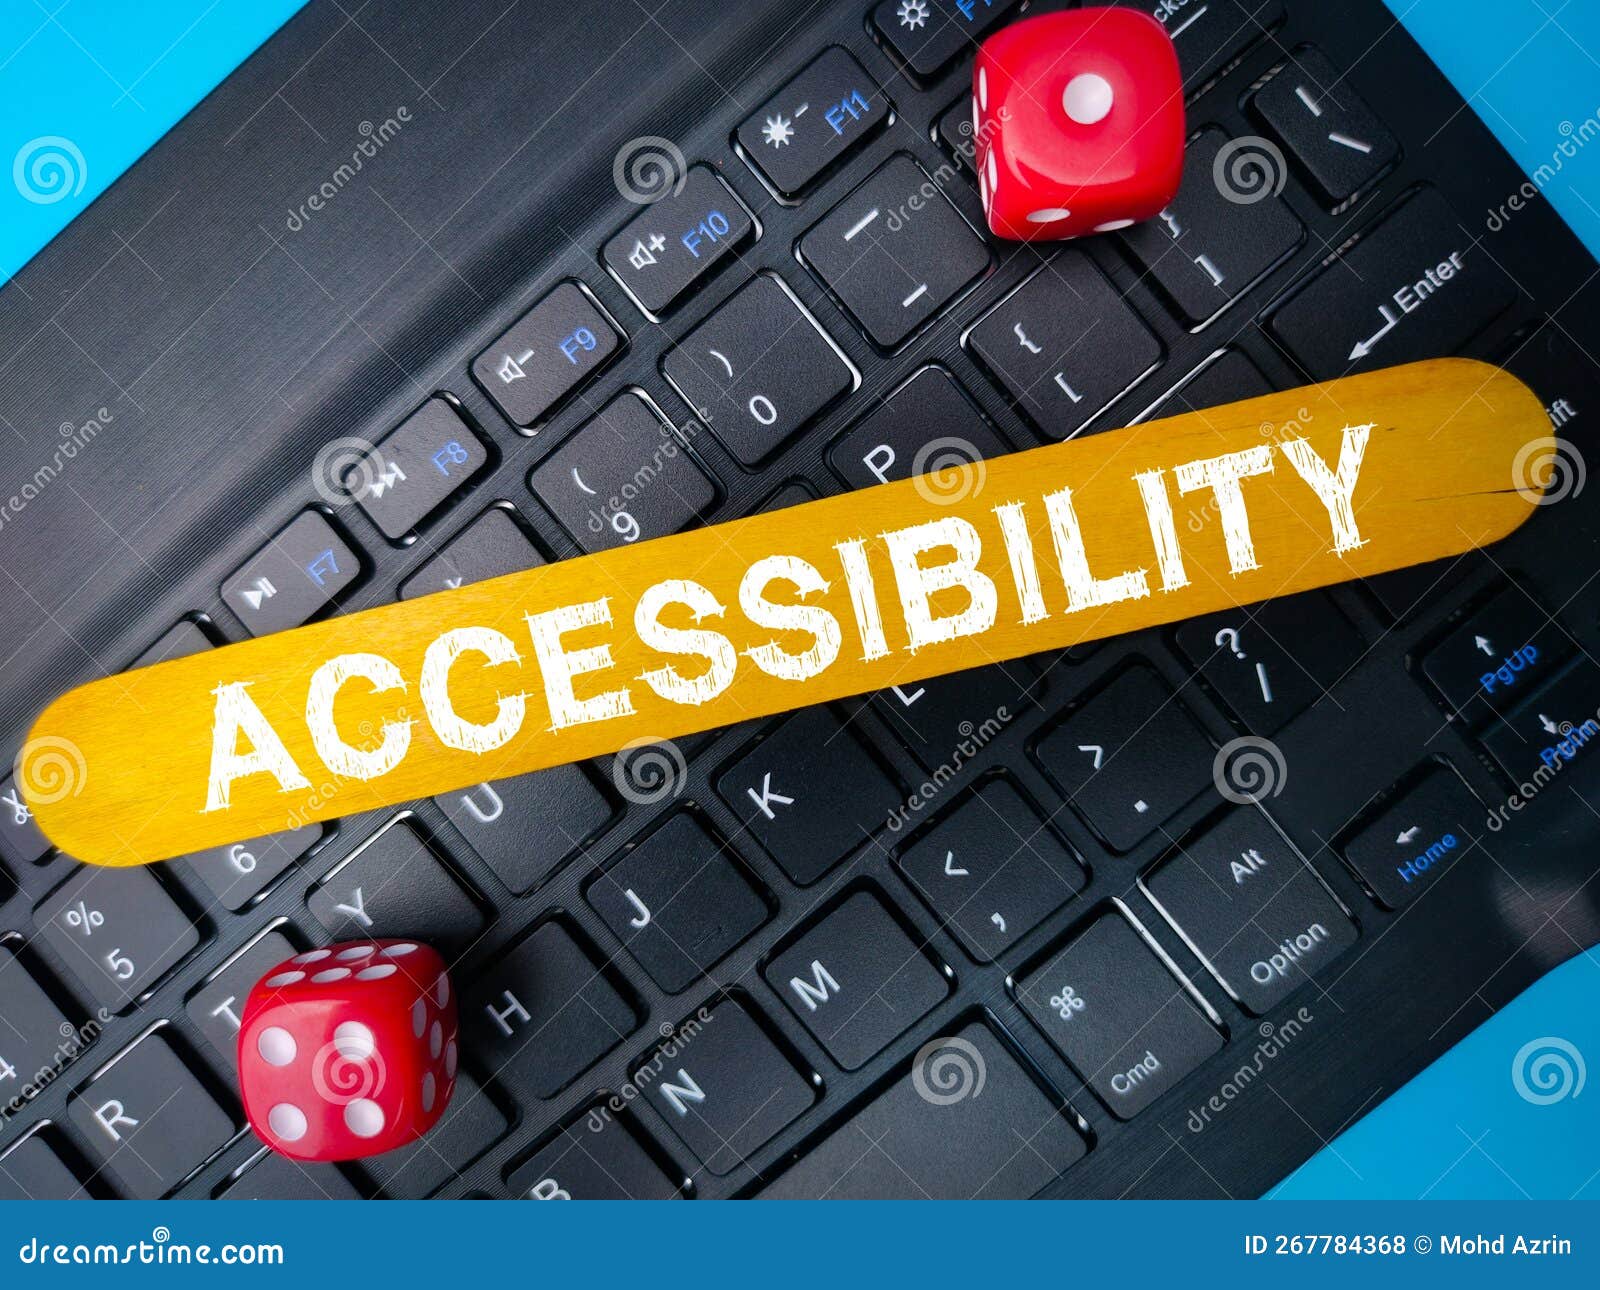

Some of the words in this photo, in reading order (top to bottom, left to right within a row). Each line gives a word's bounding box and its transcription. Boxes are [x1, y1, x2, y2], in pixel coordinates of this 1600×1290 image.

[825, 90, 869, 133] F11
[682, 210, 731, 258] F10
[1194, 255, 1223, 287] ]
[1393, 252, 1462, 314] Enter
[560, 327, 597, 363] F9
[1014, 323, 1042, 354] {
[709, 349, 734, 378] )
[1054, 372, 1083, 404] [
[1546, 399, 1575, 431] ift
[432, 440, 469, 476] F8
[863, 445, 896, 485] P
[573, 467, 597, 495] (
[611, 511, 641, 543] 9
[309, 551, 340, 585] F7
[201, 423, 1375, 814] ACCESSIBILITY
[1215, 628, 1245, 659] ?
[1479, 645, 1539, 694] PgUp
[461, 783, 504, 823] U
[748, 773, 795, 819] K
[228, 844, 257, 876] 6
[1230, 849, 1266, 884] Alt
[1397, 834, 1458, 883] Home
[66, 901, 105, 936] %
[335, 886, 373, 926] Y
[624, 888, 651, 928] J
[106, 948, 135, 980] 5
[1250, 924, 1327, 984] Option
[790, 959, 841, 1010] M
[211, 995, 242, 1031] T
[486, 989, 532, 1036] H
[660, 1068, 706, 1114] N
[1110, 1050, 1160, 1093] Cmd
[94, 1099, 139, 1141] R
